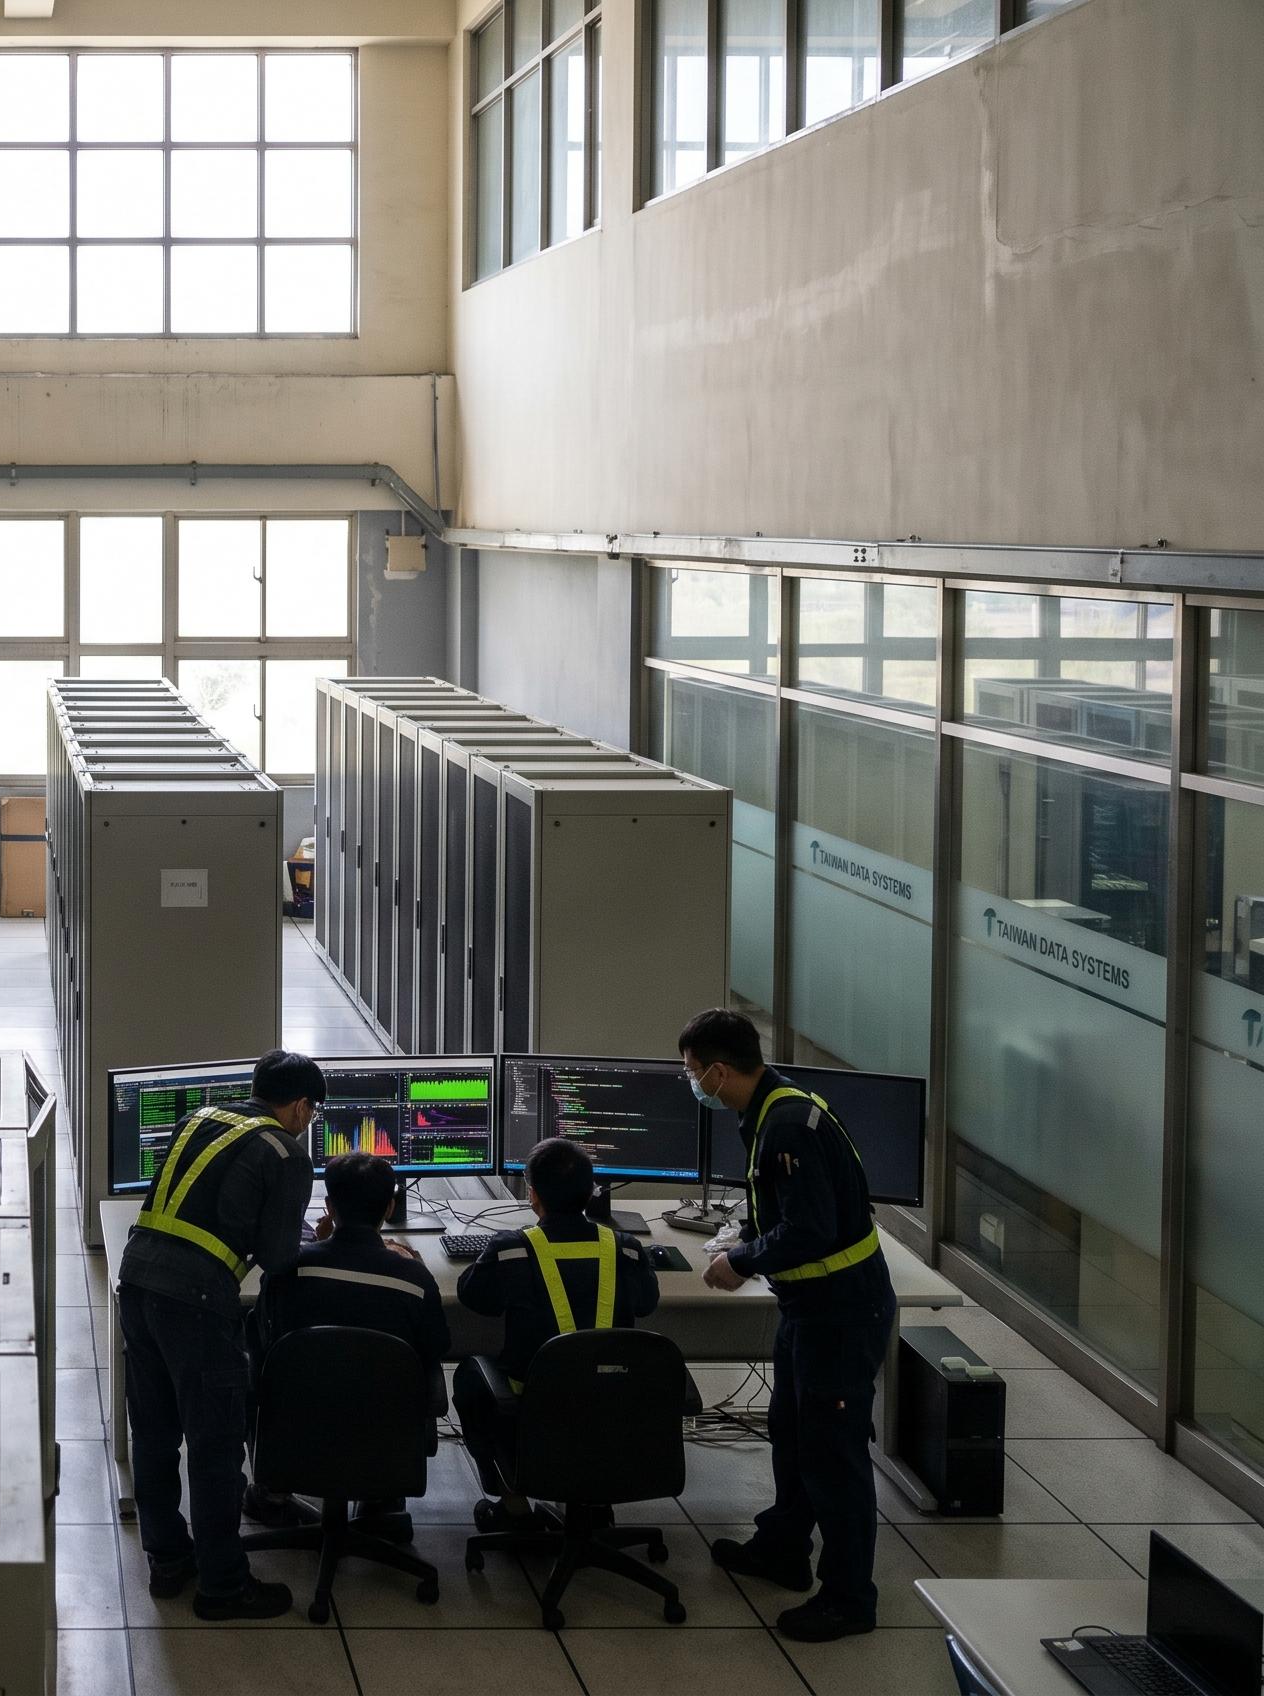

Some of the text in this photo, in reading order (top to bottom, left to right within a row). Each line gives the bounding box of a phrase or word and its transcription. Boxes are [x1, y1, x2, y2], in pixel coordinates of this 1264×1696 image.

[819, 849, 912, 900] TAIWAN DATA SYSTEMS
[997, 920, 1130, 989] TAIWAN DATA SYSTEMS
